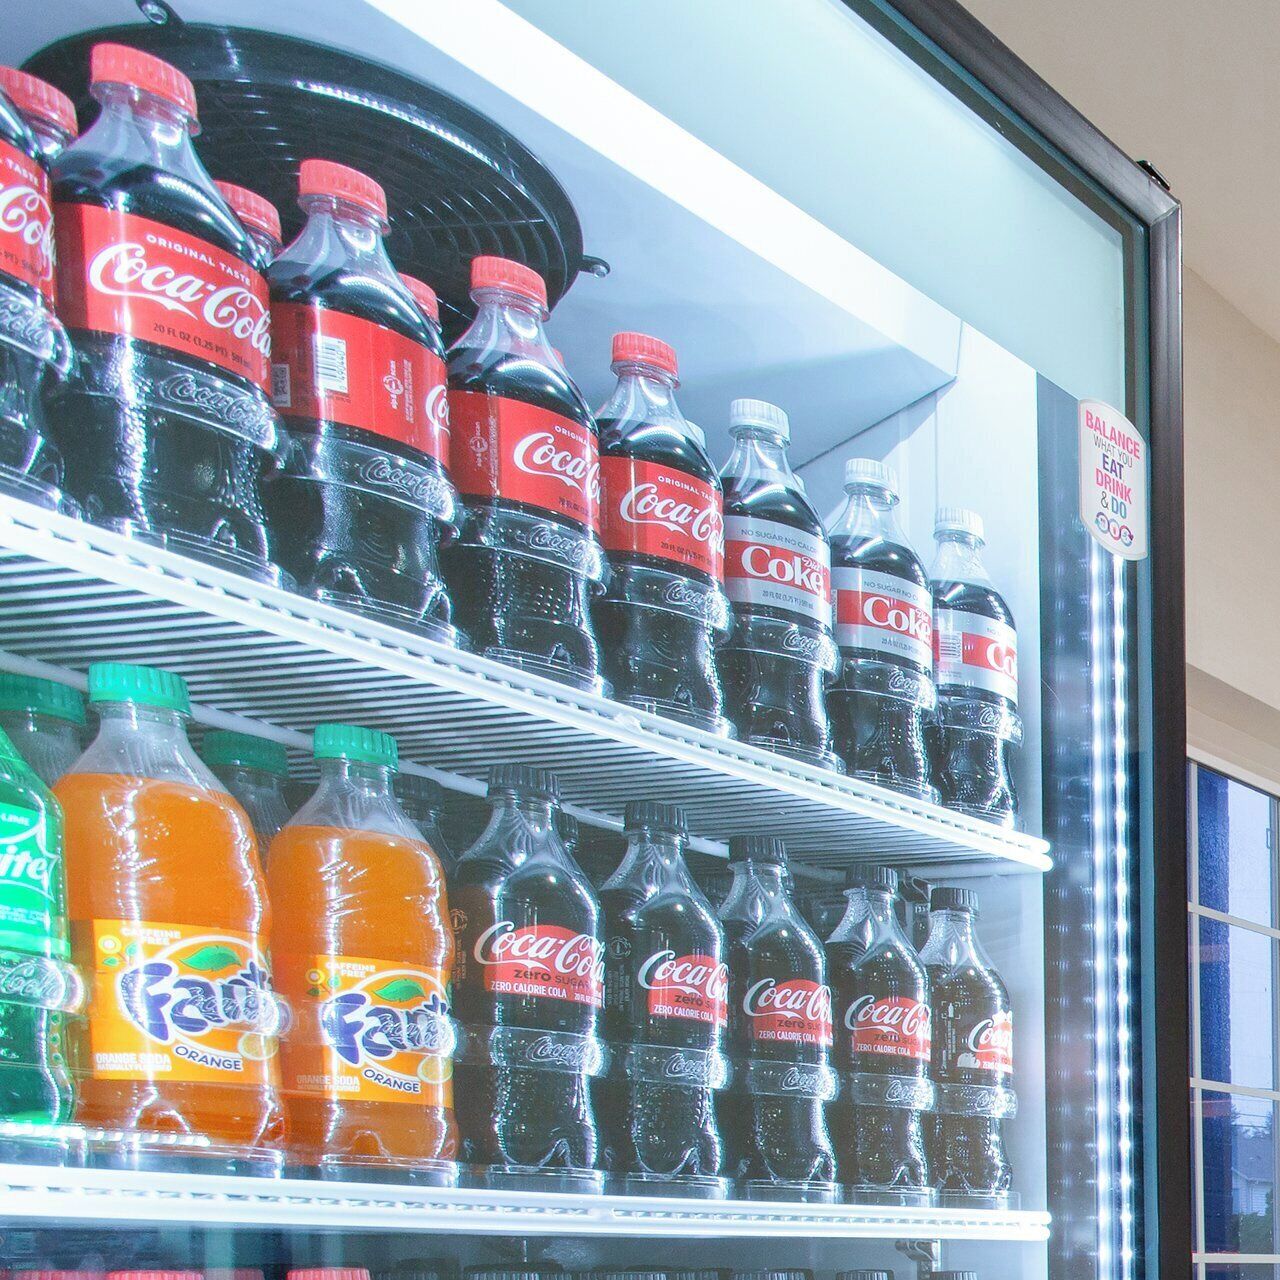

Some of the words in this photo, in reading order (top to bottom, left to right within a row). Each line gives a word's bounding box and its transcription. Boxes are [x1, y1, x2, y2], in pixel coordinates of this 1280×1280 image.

[146, 234, 215, 267] ORIGINAL
[218, 261, 251, 287] TASTE
[88, 242, 272, 358] Coca-Cola
[1086, 410, 1140, 460] BALANCE
[1094, 434, 1117, 457] WHAT
[1118, 450, 1133, 468] YOU
[513, 432, 600, 504] Coca-C
[1102, 454, 1124, 480] EAT
[658, 475, 700, 497] ORIGINAL
[1096, 468, 1132, 504] DRINK
[1111, 496, 1127, 519] DO
[755, 531, 784, 543] SUGAR
[741, 545, 826, 596] Coke
[863, 596, 931, 641] Coke
[986, 639, 1017, 678] Co
[514, 967, 552, 982] zero
[491, 980, 511, 992] ZERO
[513, 983, 547, 996] CALORIE
[549, 986, 567, 998] COLA
[654, 1004, 673, 1015] ZERO
[674, 1006, 700, 1018] CALORIE
[758, 1030, 776, 1040] ZERO
[777, 1031, 802, 1041] CALORIE
[174, 1044, 243, 1071] ORANGE
[362, 1068, 421, 1093] ORANGE
